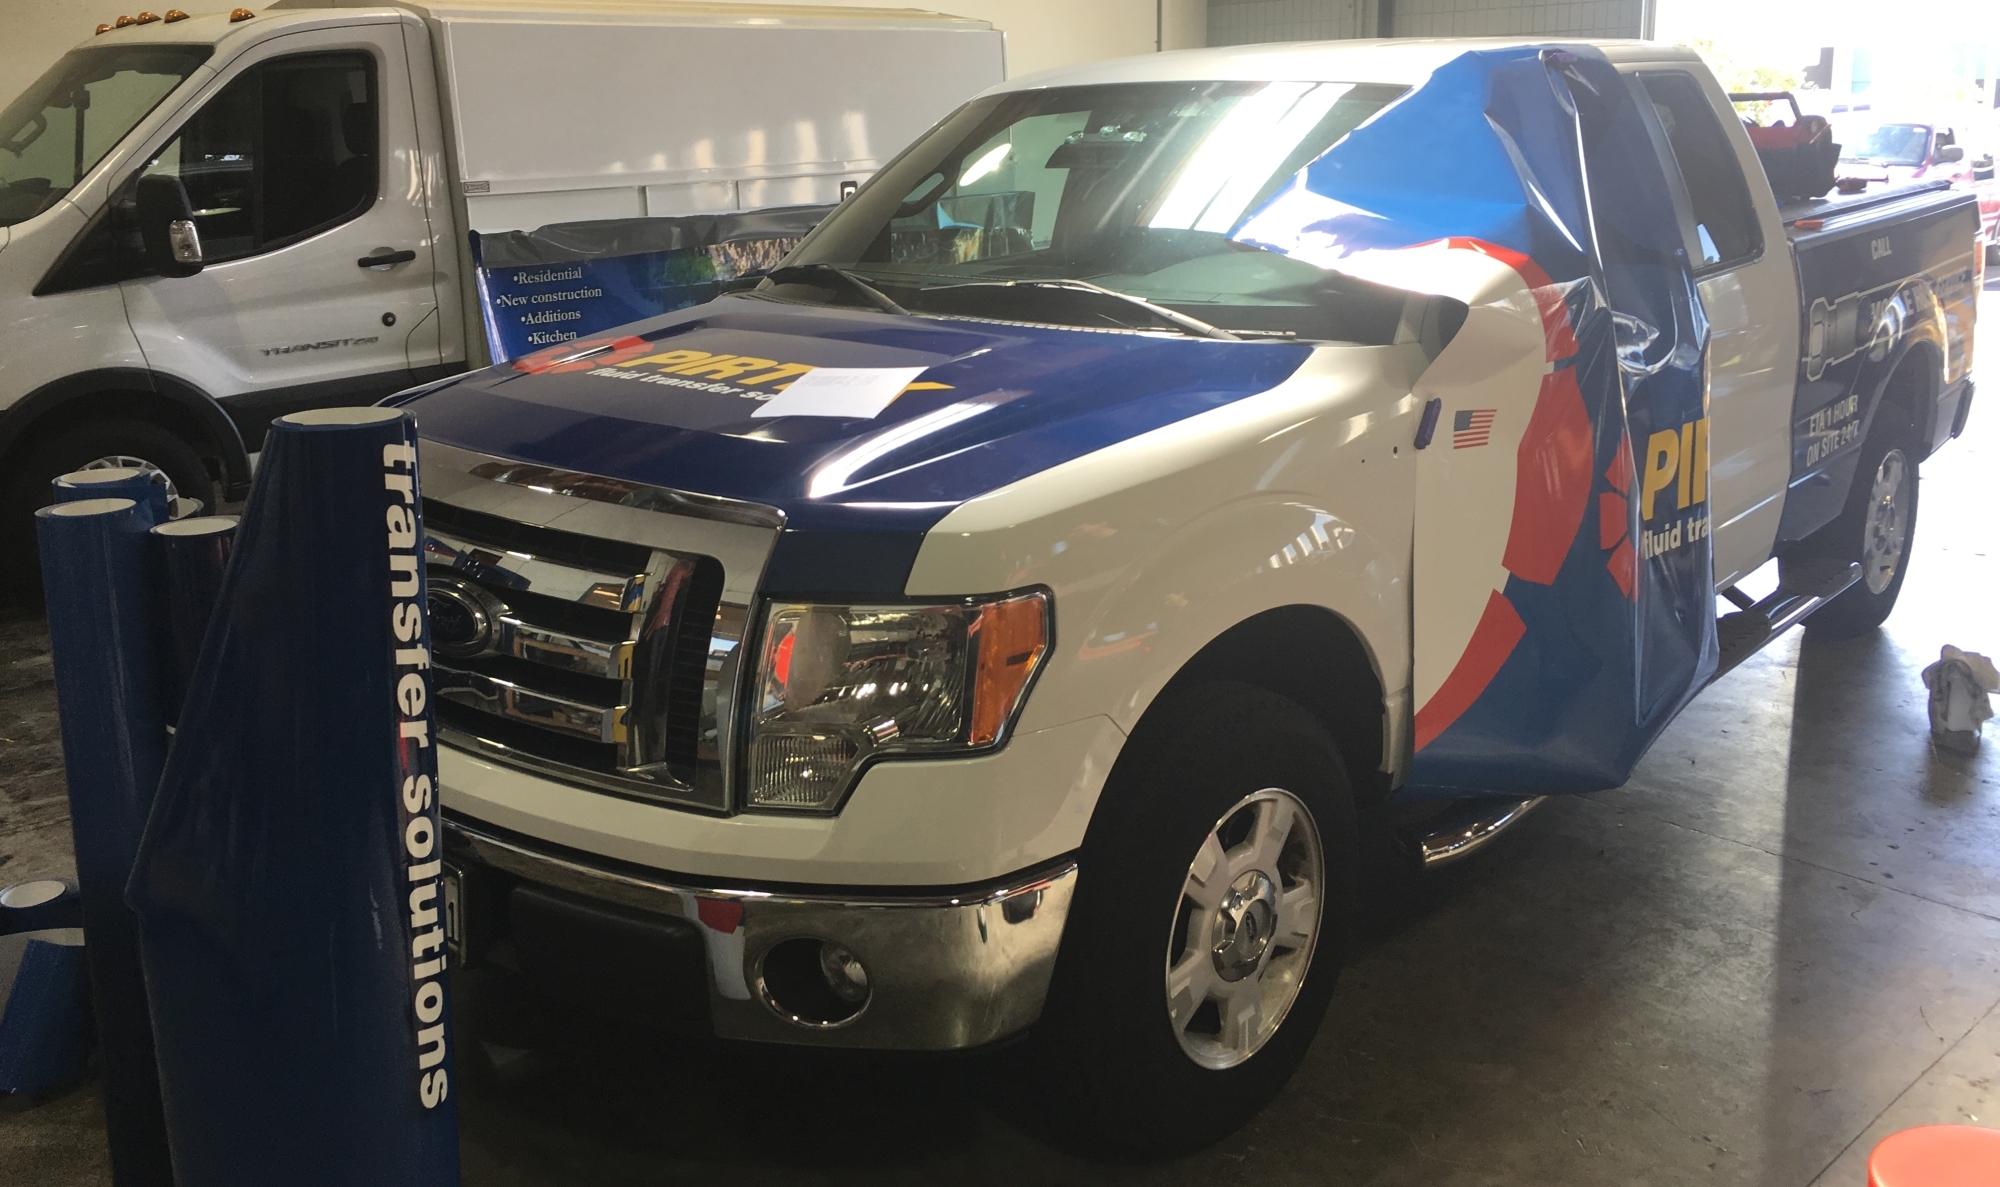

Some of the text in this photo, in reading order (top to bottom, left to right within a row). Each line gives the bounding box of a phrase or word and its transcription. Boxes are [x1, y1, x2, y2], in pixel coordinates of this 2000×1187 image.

[1871, 236, 1893, 260] CALL
[518, 267, 583, 285] Residential
[500, 286, 603, 308] New construction
[525, 309, 582, 326] Additions
[532, 329, 578, 345] Kitchen
[586, 367, 643, 381] fluid
[640, 374, 744, 396] transfer
[1809, 394, 1858, 437] ETA 1 HOUR
[1806, 441, 1820, 468] ON
[1821, 429, 1840, 458] SITE
[1642, 519, 1682, 560] fluid
[383, 440, 448, 1109] transfer solutions
